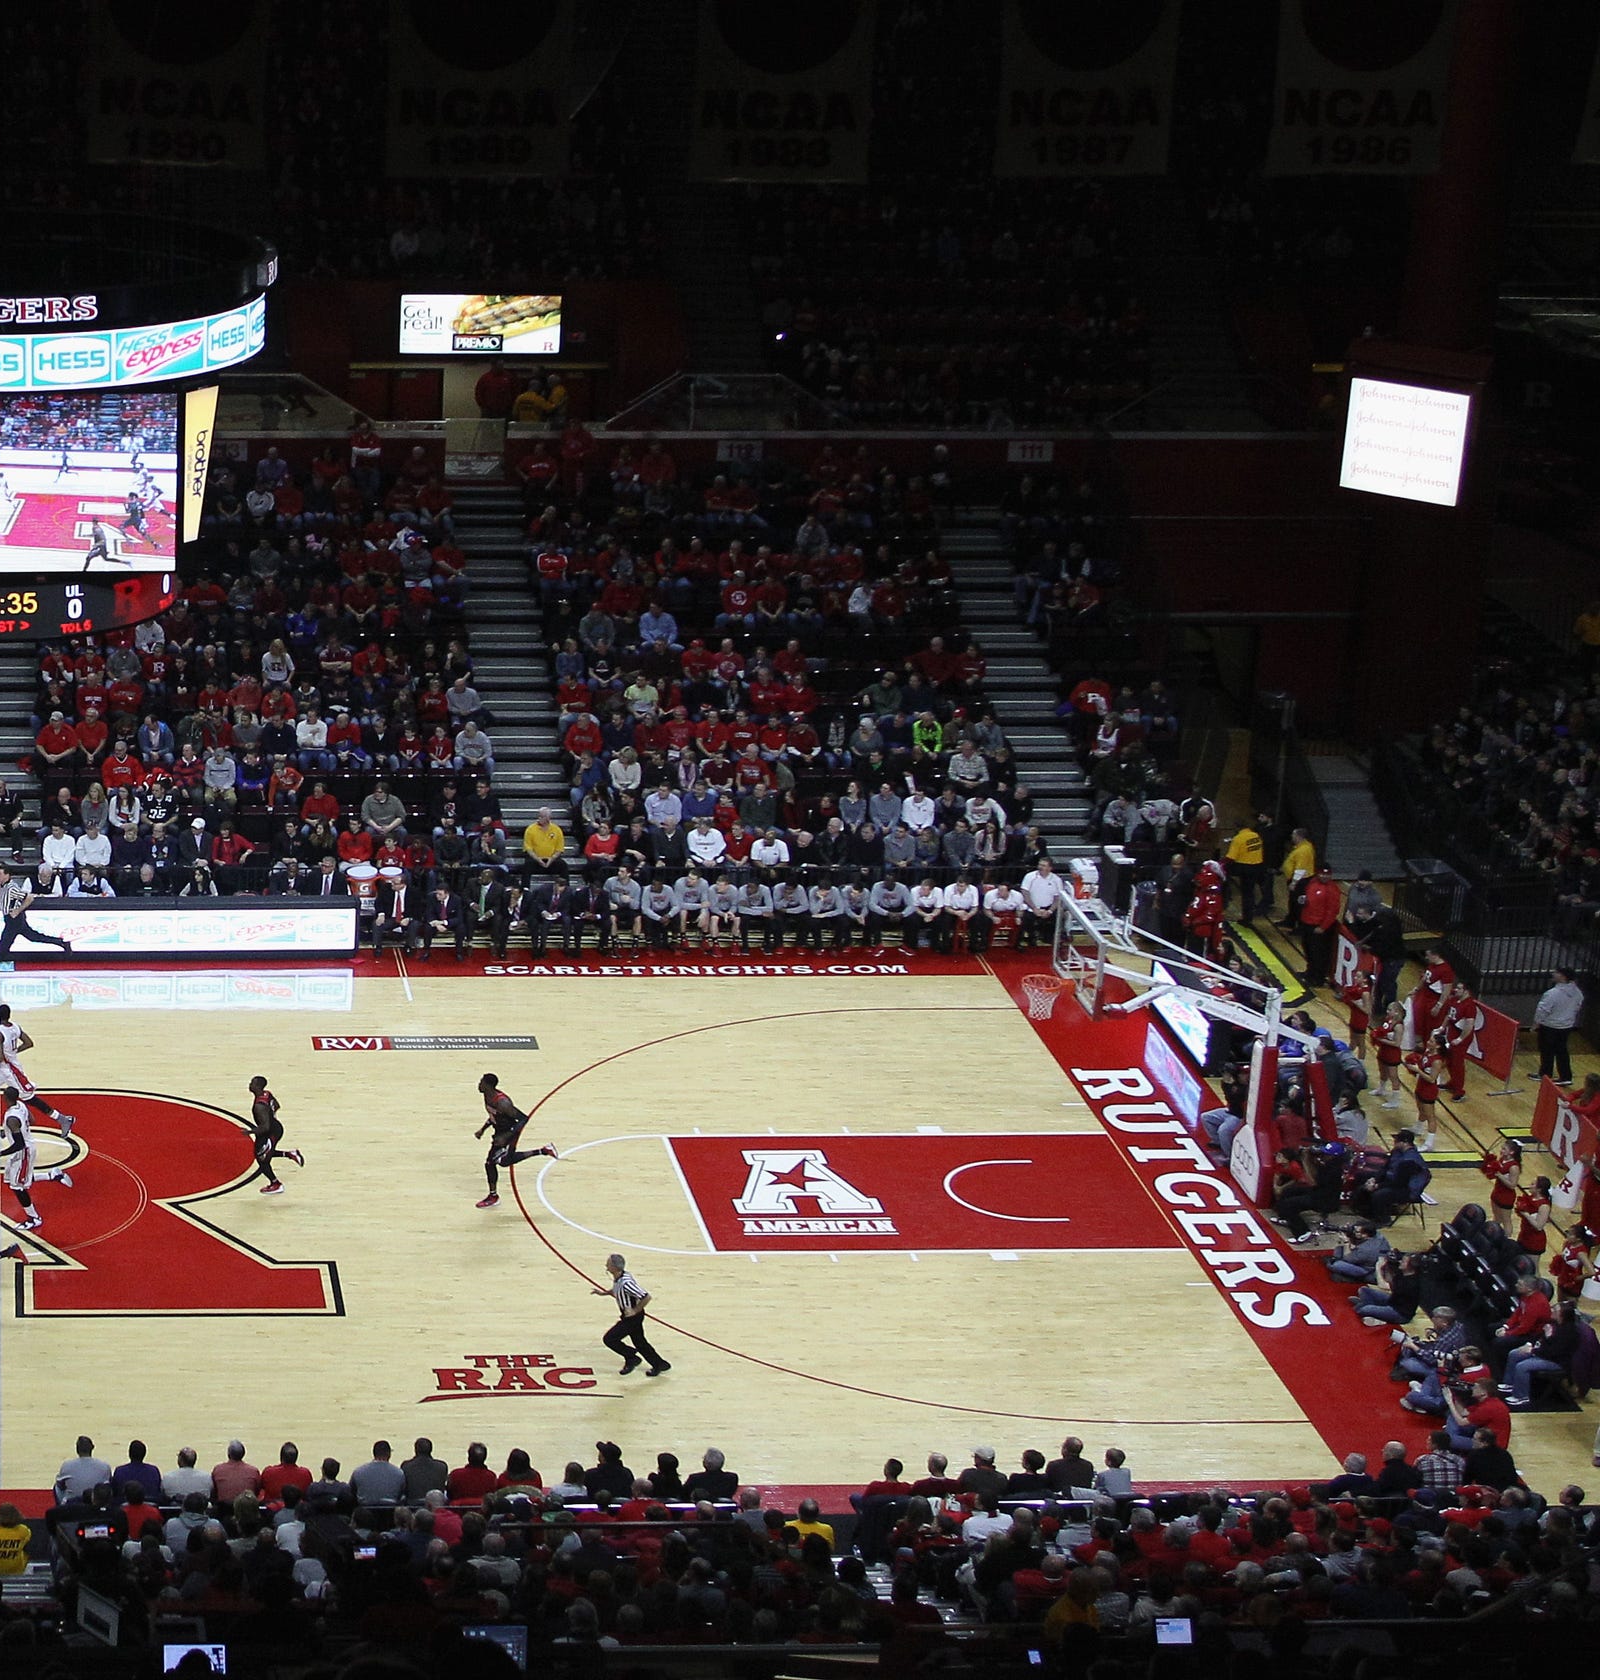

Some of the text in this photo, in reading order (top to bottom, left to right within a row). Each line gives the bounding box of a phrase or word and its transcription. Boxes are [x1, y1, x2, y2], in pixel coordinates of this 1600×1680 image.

[1284, 87, 1437, 129] NCAA
[403, 305, 432, 318] Get
[403, 316, 442, 330] real!
[119, 328, 171, 356] HESS
[211, 325, 245, 351] HESS
[455, 336, 501, 350] PREMIO
[37, 350, 105, 369] HESS
[192, 429, 208, 498] brother
[65, 585, 84, 597] UL
[67, 599, 83, 619] 0
[60, 623, 82, 634] TOL
[151, 661, 166, 674] R
[128, 925, 168, 935] HESS
[182, 924, 222, 935] HESS
[1335, 934, 1360, 988] R
[318, 1037, 384, 1051] RWJ
[1550, 1098, 1580, 1170] R
[732, 1150, 885, 1214] A
[1559, 1177, 1573, 1194] R
[1070, 1068, 1334, 1329] RUTGERS
[743, 1220, 897, 1233] AMERICAN
[464, 1354, 557, 1368] THE
[432, 1367, 597, 1390] RAC
